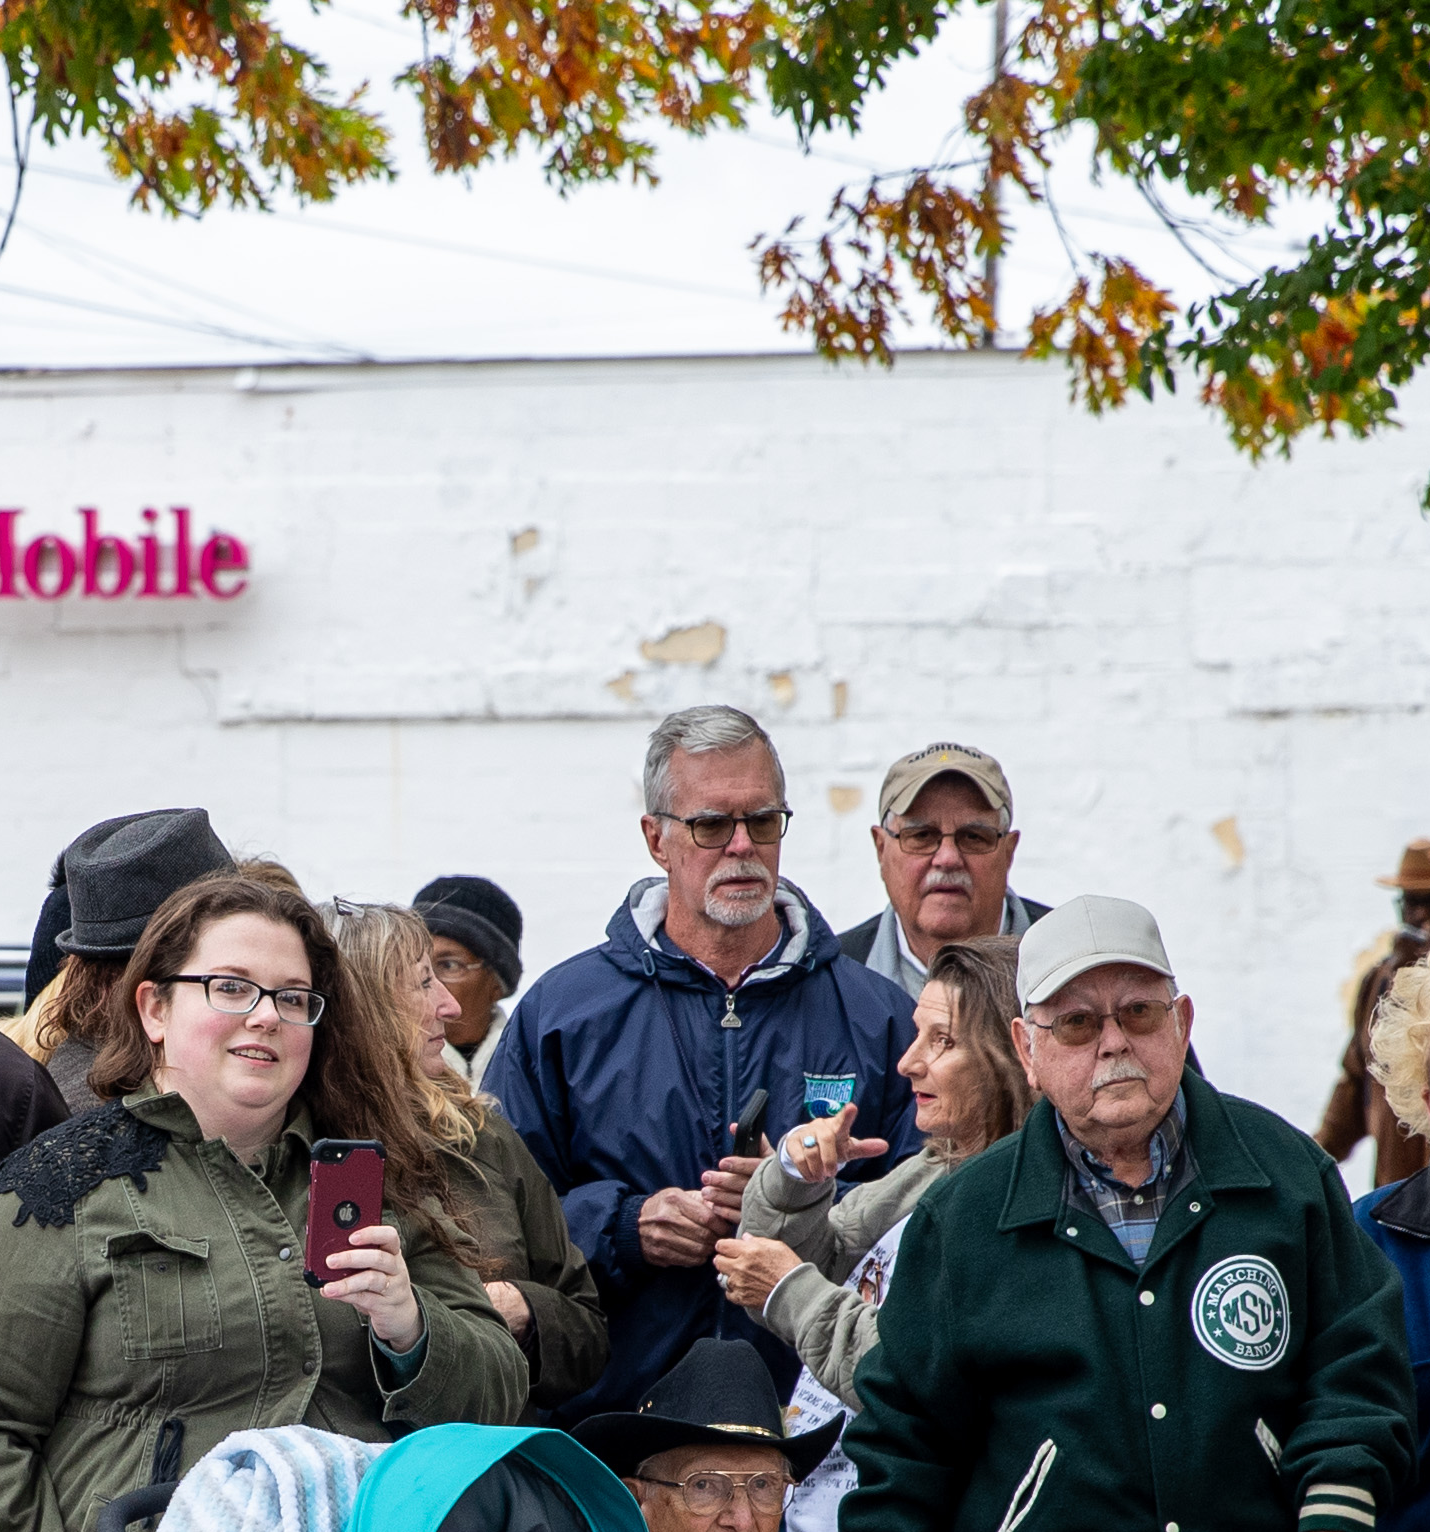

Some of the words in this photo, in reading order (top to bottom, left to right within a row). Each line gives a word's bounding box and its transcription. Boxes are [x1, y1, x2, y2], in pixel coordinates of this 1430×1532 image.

[1207, 1269, 1278, 1307] MARCHING
[1222, 1290, 1272, 1337] MSU
[1233, 1342, 1272, 1357] BAND
